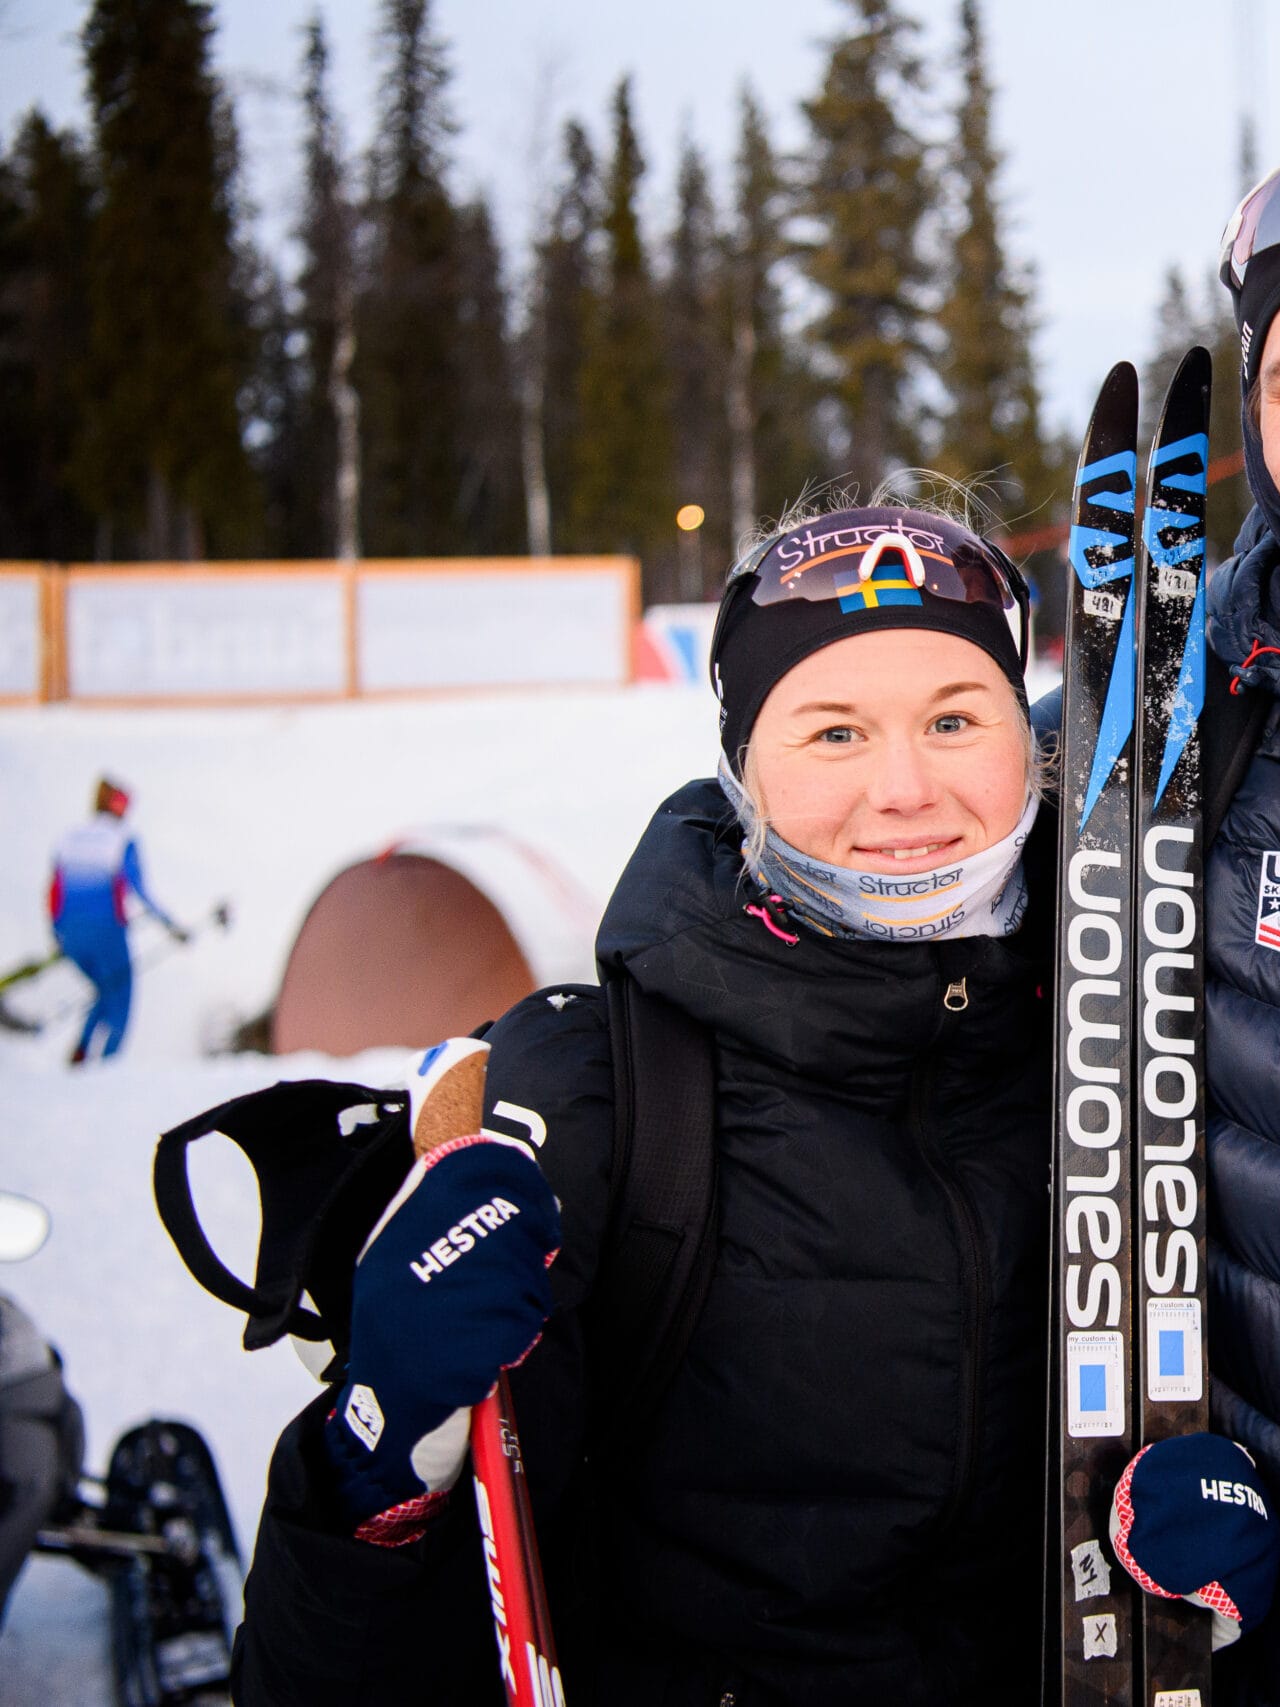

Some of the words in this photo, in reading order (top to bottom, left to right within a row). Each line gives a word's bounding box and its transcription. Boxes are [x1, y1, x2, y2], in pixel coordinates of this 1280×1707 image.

[775, 518, 945, 572] Structor
[858, 867, 964, 896] Structor
[1065, 849, 1123, 1328] salomon
[1143, 824, 1198, 1294] salomon
[410, 1197, 520, 1283] HESTRA
[1200, 1478, 1268, 1521] HESTRA
